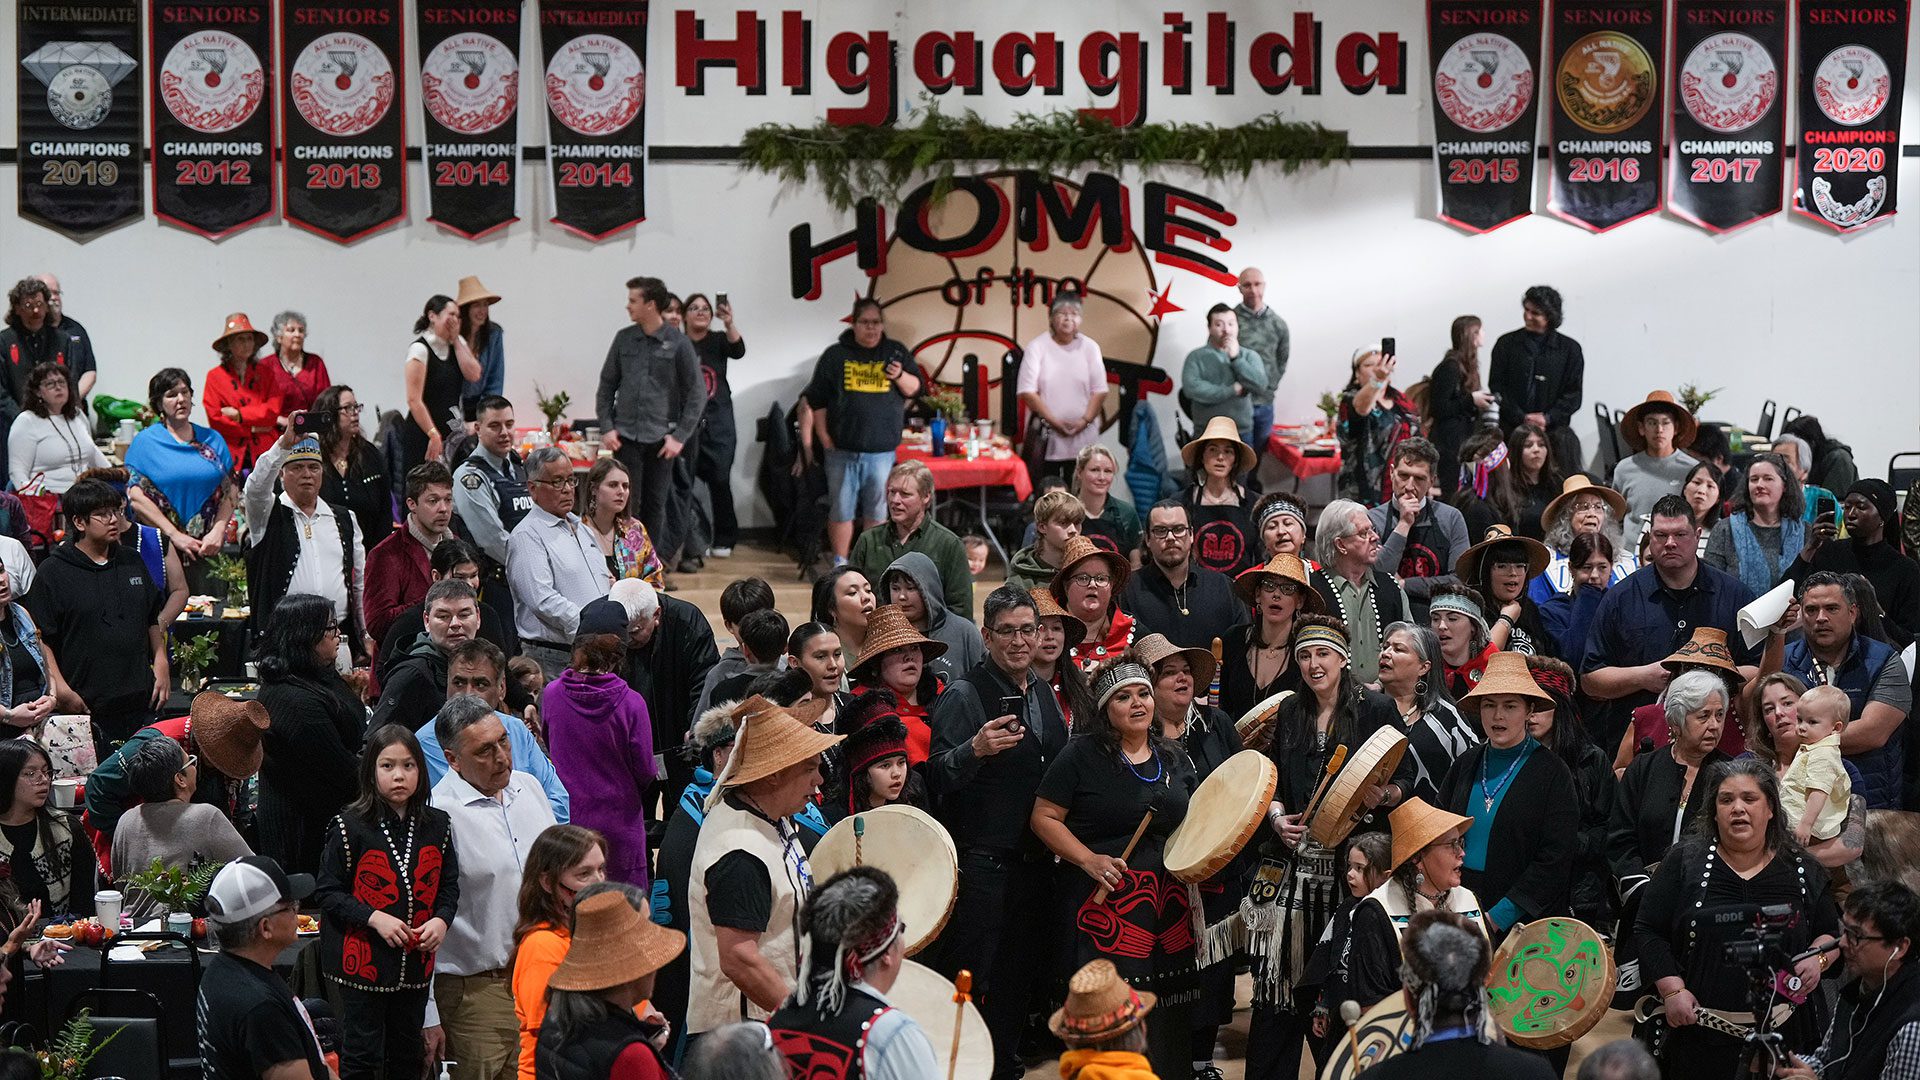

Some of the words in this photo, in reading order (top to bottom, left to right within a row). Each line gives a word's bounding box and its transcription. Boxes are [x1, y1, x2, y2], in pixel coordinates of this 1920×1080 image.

[23, 6, 136, 22] INTERMEDIATE
[163, 7, 260, 24] SENIORS
[294, 8, 391, 25] SENIORS
[424, 9, 518, 25] SENIORS
[1441, 10, 1530, 25] SENIORS
[1564, 9, 1653, 25] SENIORS
[1687, 9, 1775, 25] SENIORS
[1809, 9, 1897, 24] SENIORS
[184, 39, 200, 50] ALL
[314, 41, 331, 53] ALL
[568, 43, 584, 54] ALL
[1805, 130, 1896, 144] CHAMPIONS
[30, 141, 131, 157] CHAMPIONS
[163, 142, 263, 157] CHAMPIONS
[294, 145, 393, 159] CHAMPIONS
[550, 144, 644, 158] CHAMPIONS
[1438, 141, 1531, 155] CHAMPIONS
[1558, 140, 1652, 154] CHAMPIONS
[1680, 141, 1774, 154] CHAMPIONS
[1814, 148, 1886, 173] 2020
[42, 160, 118, 185] 2019
[176, 160, 251, 185] 2012
[307, 163, 381, 188] 2013
[436, 161, 509, 186] 2014
[559, 162, 633, 187] 2014
[1448, 158, 1519, 183] 2015
[1569, 158, 1640, 182] 2016
[1690, 158, 1761, 183] 2017
[789, 171, 1239, 302] HOME
[942, 267, 994, 306] of
[512, 496, 533, 511] POLI
